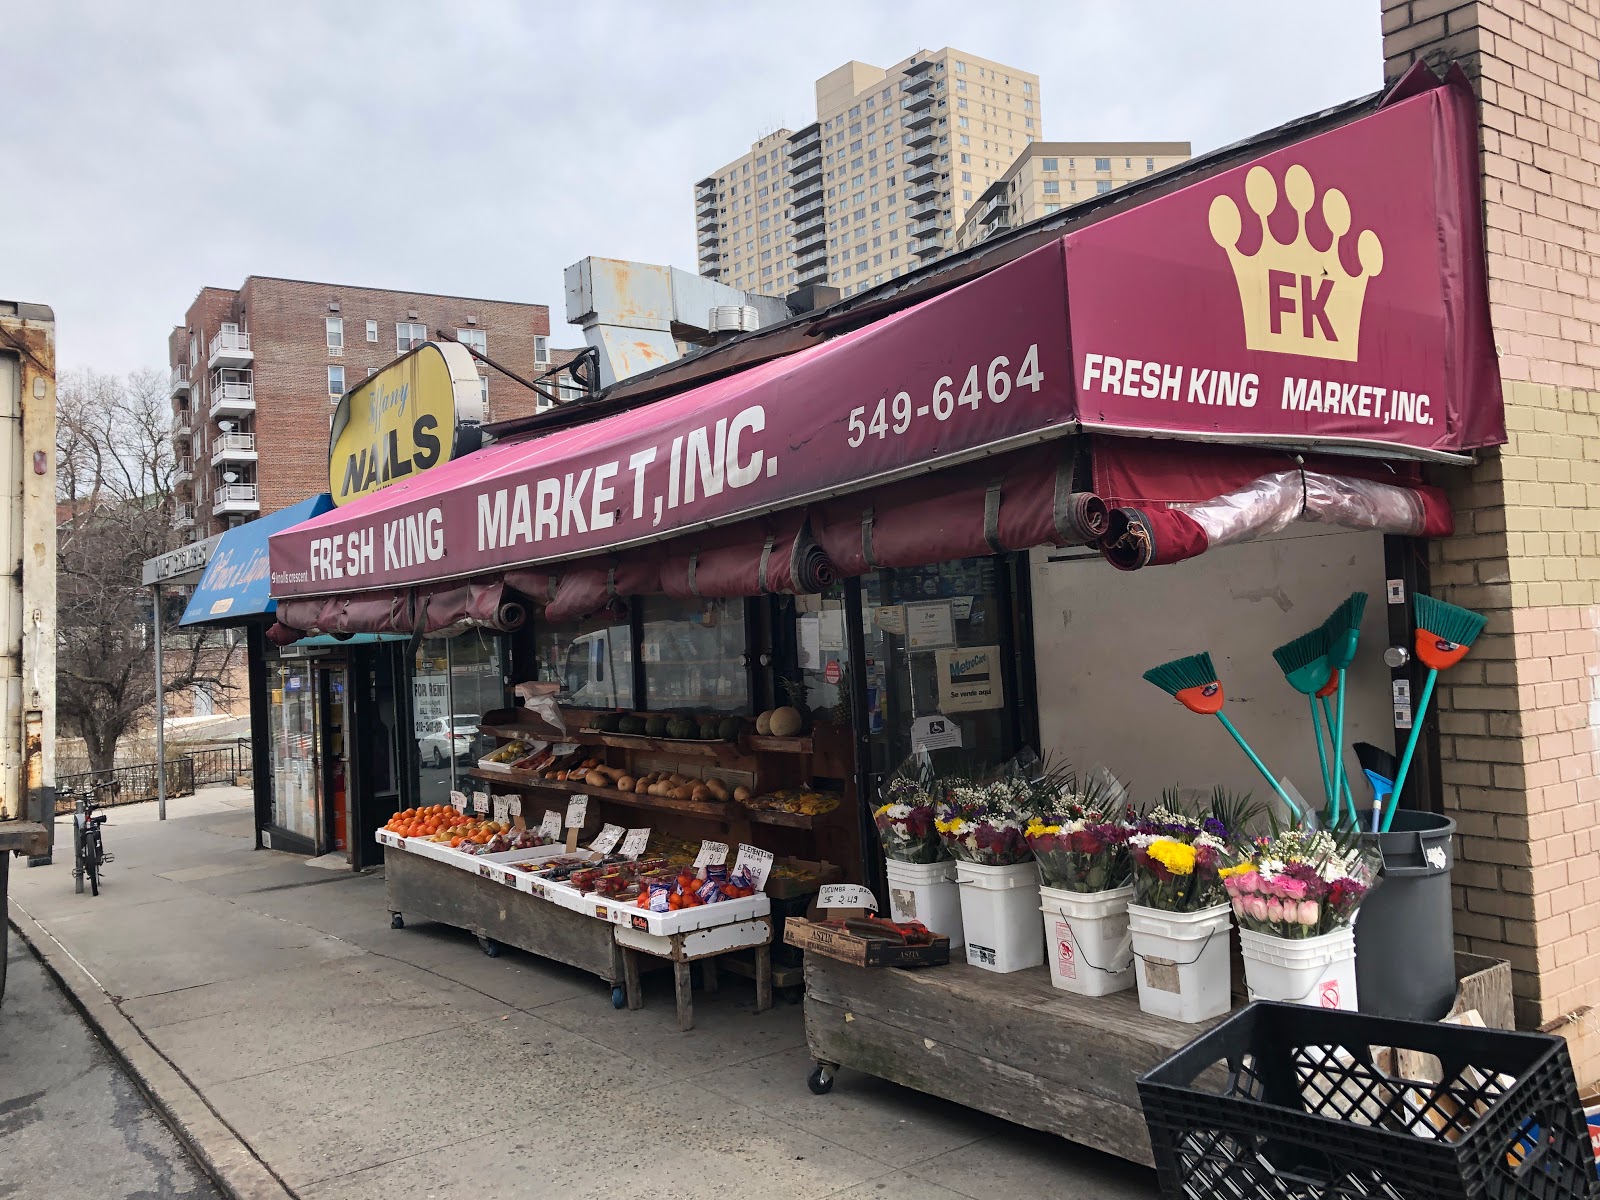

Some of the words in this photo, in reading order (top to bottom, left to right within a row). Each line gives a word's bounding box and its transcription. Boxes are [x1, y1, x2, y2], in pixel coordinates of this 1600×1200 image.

[1268, 268, 1339, 342] FK
[847, 343, 1045, 450] 549-6464
[1082, 353, 1183, 402] FRESH
[1187, 367, 1259, 408] KING
[1280, 376, 1434, 426] MARKET,INC.
[340, 414, 441, 497] NAILS
[310, 526, 375, 582] FRESH
[383, 507, 445, 571] KING
[477, 404, 778, 552] MARKET,INC.
[288, 569, 309, 584] crescent
[414, 683, 428, 697] FOR
[429, 683, 446, 697] RENT
[950, 653, 987, 677] MetroCard
[960, 690, 977, 698] vende
